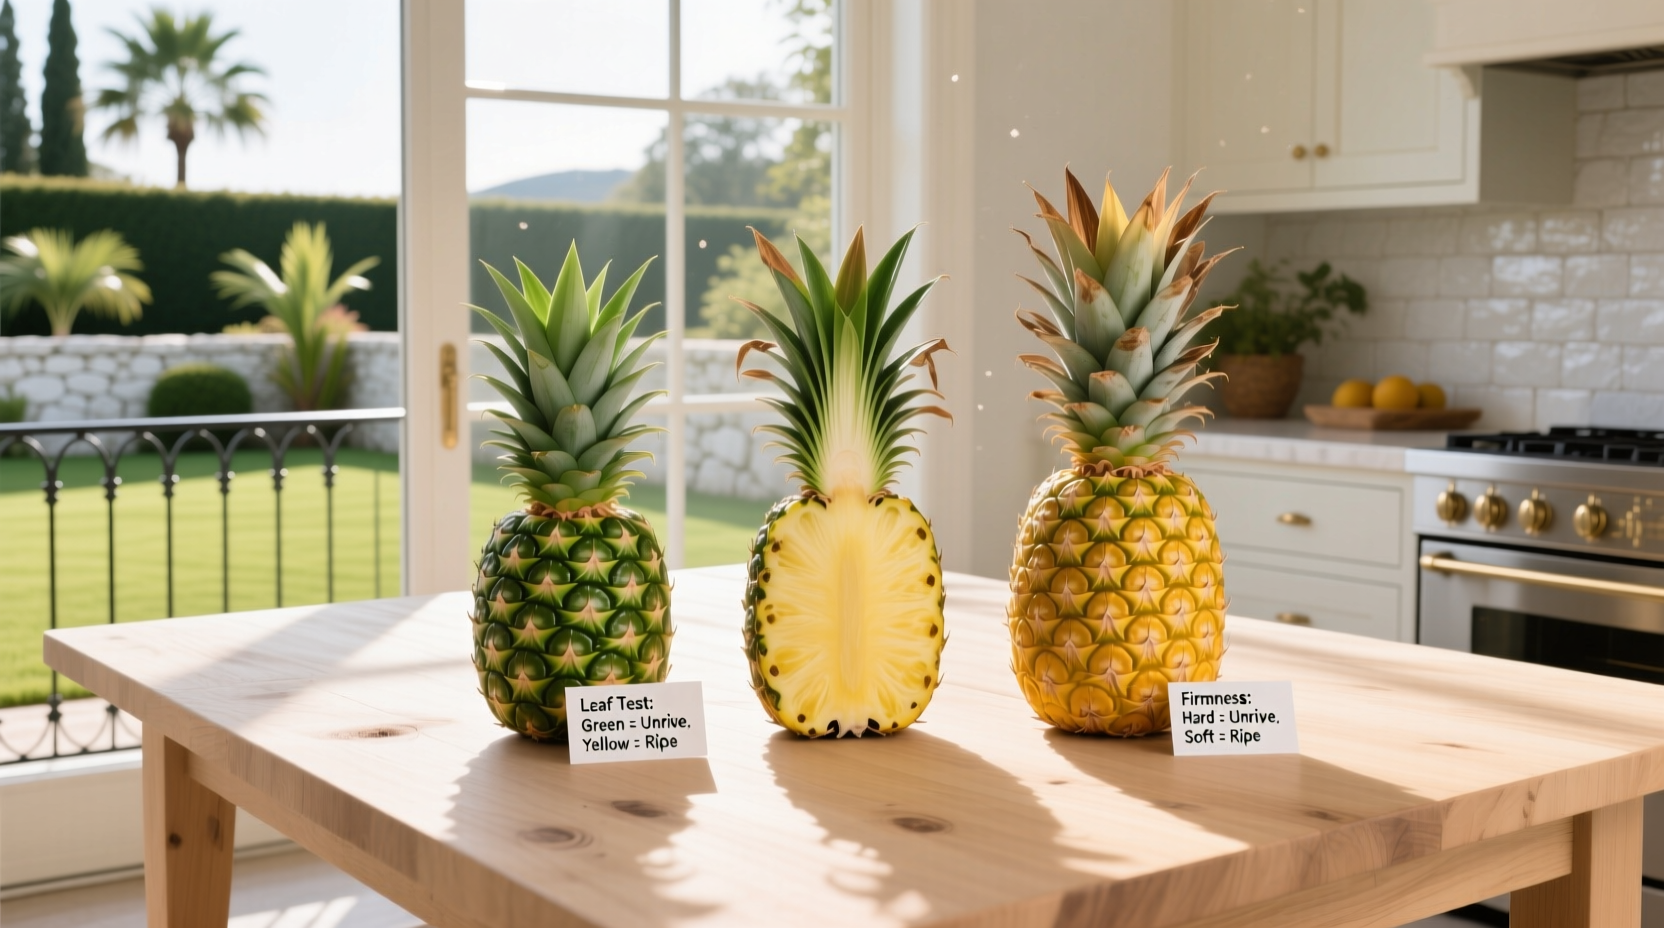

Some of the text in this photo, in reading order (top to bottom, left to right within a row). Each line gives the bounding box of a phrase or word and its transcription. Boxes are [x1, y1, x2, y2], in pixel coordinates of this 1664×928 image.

[580, 696, 653, 712] Leaf Test:
[1181, 691, 1252, 706] Firmness:
[1182, 709, 1215, 724] Hard
[581, 719, 625, 732] Green
[582, 736, 630, 752] Yellow
[645, 733, 678, 752] Ripe
[1185, 729, 1215, 744] Soft
[1230, 729, 1261, 746] Ripe
